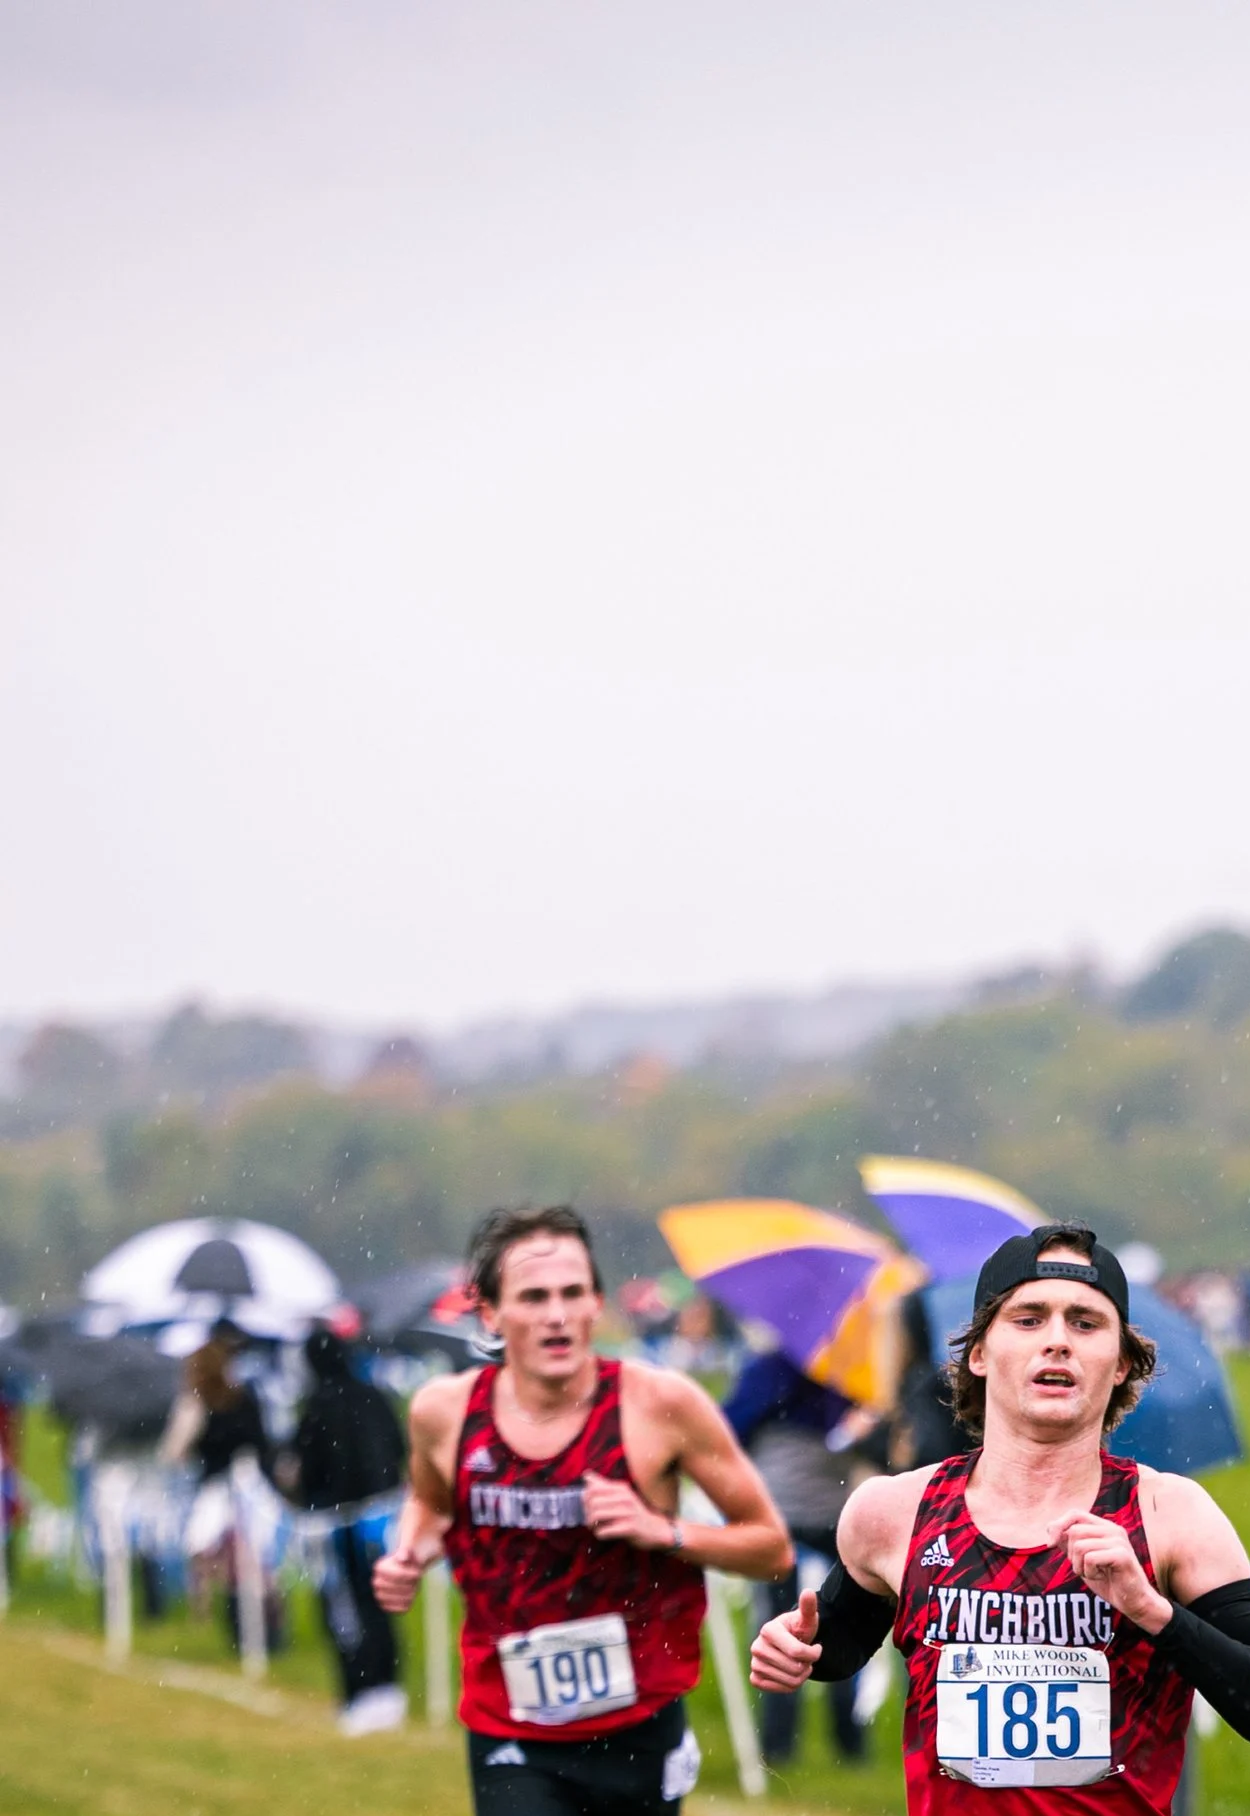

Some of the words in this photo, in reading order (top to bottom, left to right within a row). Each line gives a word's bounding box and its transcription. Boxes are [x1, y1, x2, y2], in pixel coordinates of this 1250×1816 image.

[986, 1664, 1102, 1678] INVITATIONAL
[993, 1649, 1030, 1661] MIKE
[1034, 1650, 1088, 1662] WOODS
[527, 1646, 609, 1707] 190
[966, 1682, 1081, 1758] 185
